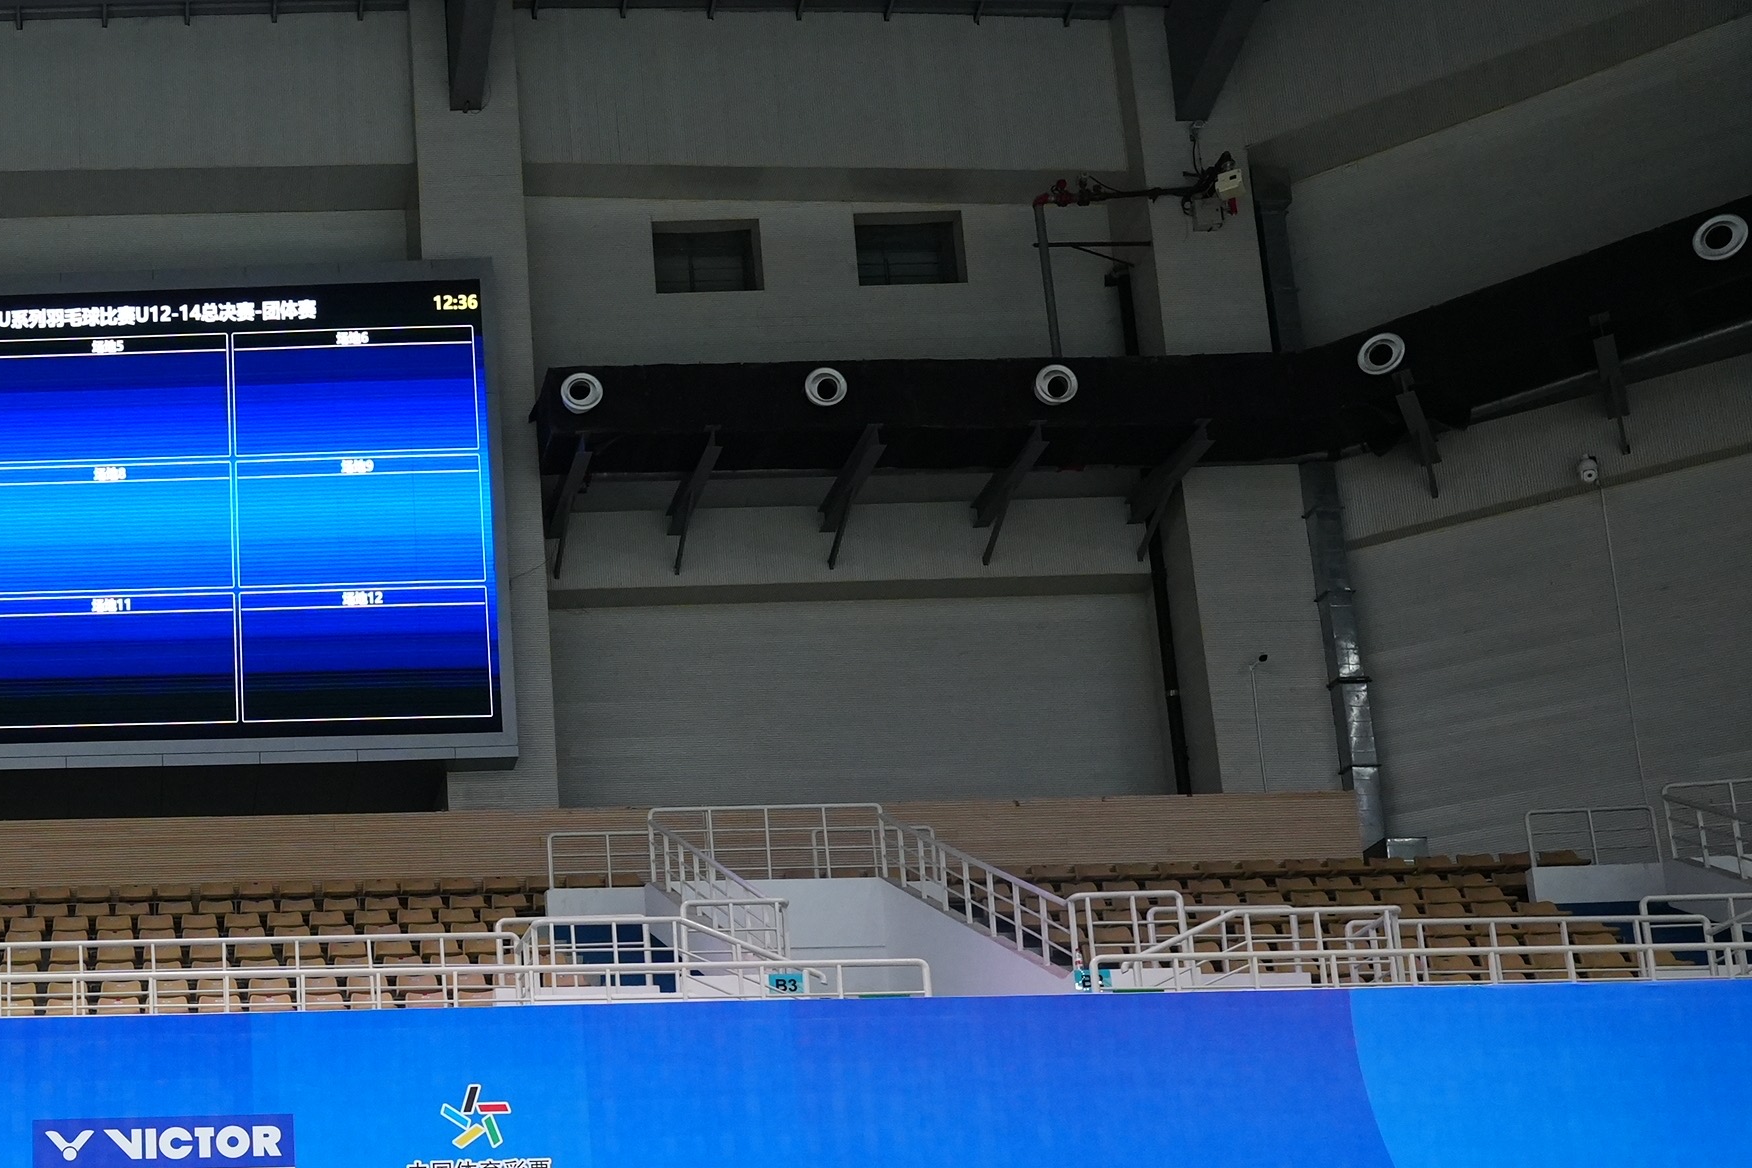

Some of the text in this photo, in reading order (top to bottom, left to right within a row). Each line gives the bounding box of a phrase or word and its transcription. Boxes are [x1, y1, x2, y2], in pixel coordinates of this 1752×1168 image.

[433, 293, 479, 311] 12:36
[776, 978, 798, 992] B3
[104, 1125, 283, 1160] VICTOR
